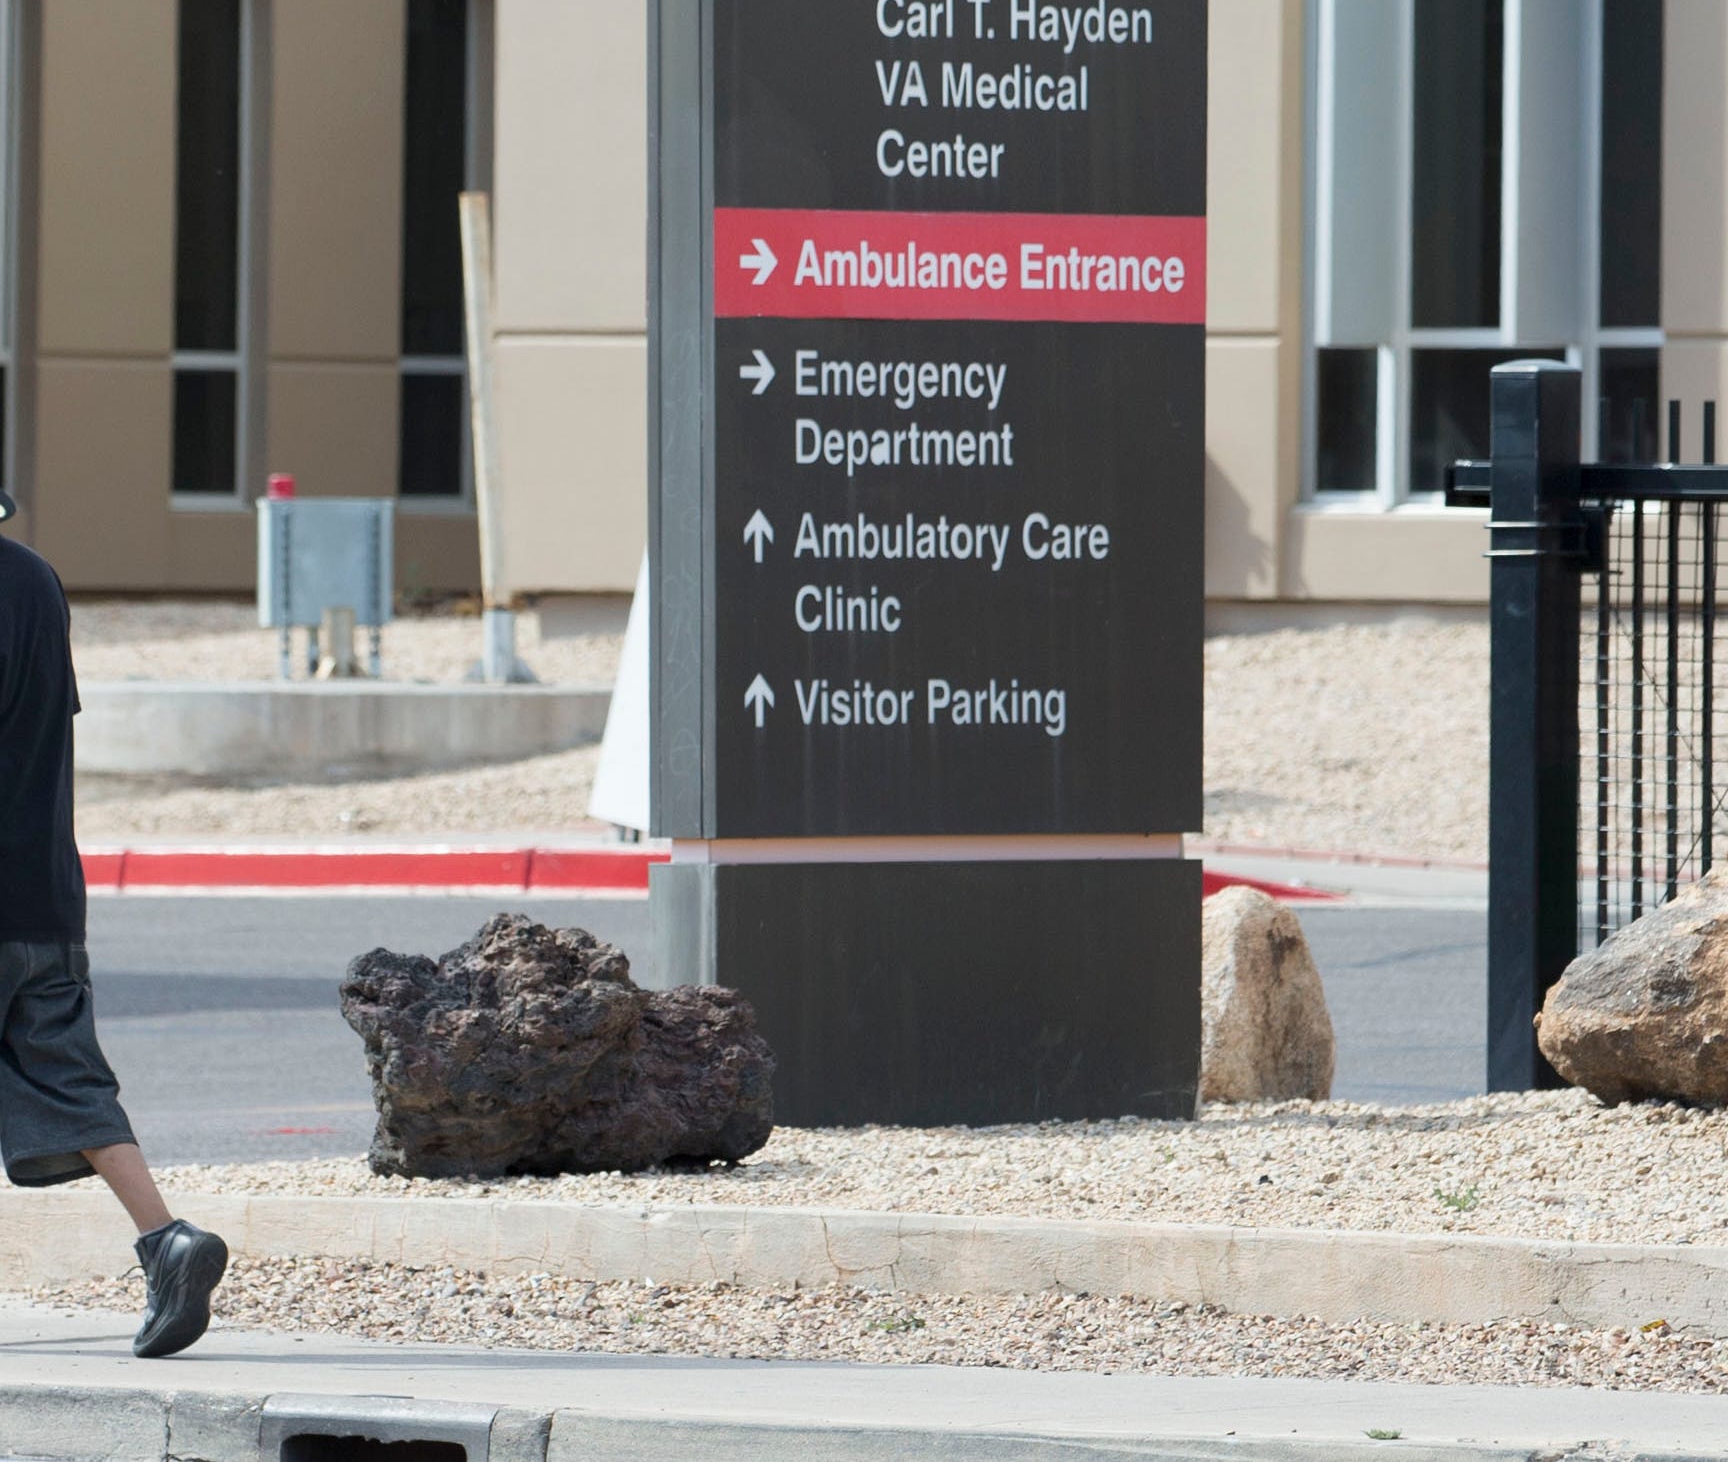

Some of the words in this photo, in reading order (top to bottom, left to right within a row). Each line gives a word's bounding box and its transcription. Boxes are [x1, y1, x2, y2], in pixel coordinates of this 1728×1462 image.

[875, 59, 928, 107] VA
[941, 61, 1088, 111] Medical
[876, 129, 1005, 179] Center
[794, 238, 1008, 290] Ambulance
[1020, 242, 1185, 293] Entrance
[795, 349, 1006, 410] Emergency
[795, 418, 1014, 478] Department
[794, 511, 1010, 571] Ambulatory
[1022, 511, 1109, 561] Care
[795, 584, 901, 633] Clinic
[794, 678, 915, 726] Visitor
[927, 678, 1066, 736] Parking
